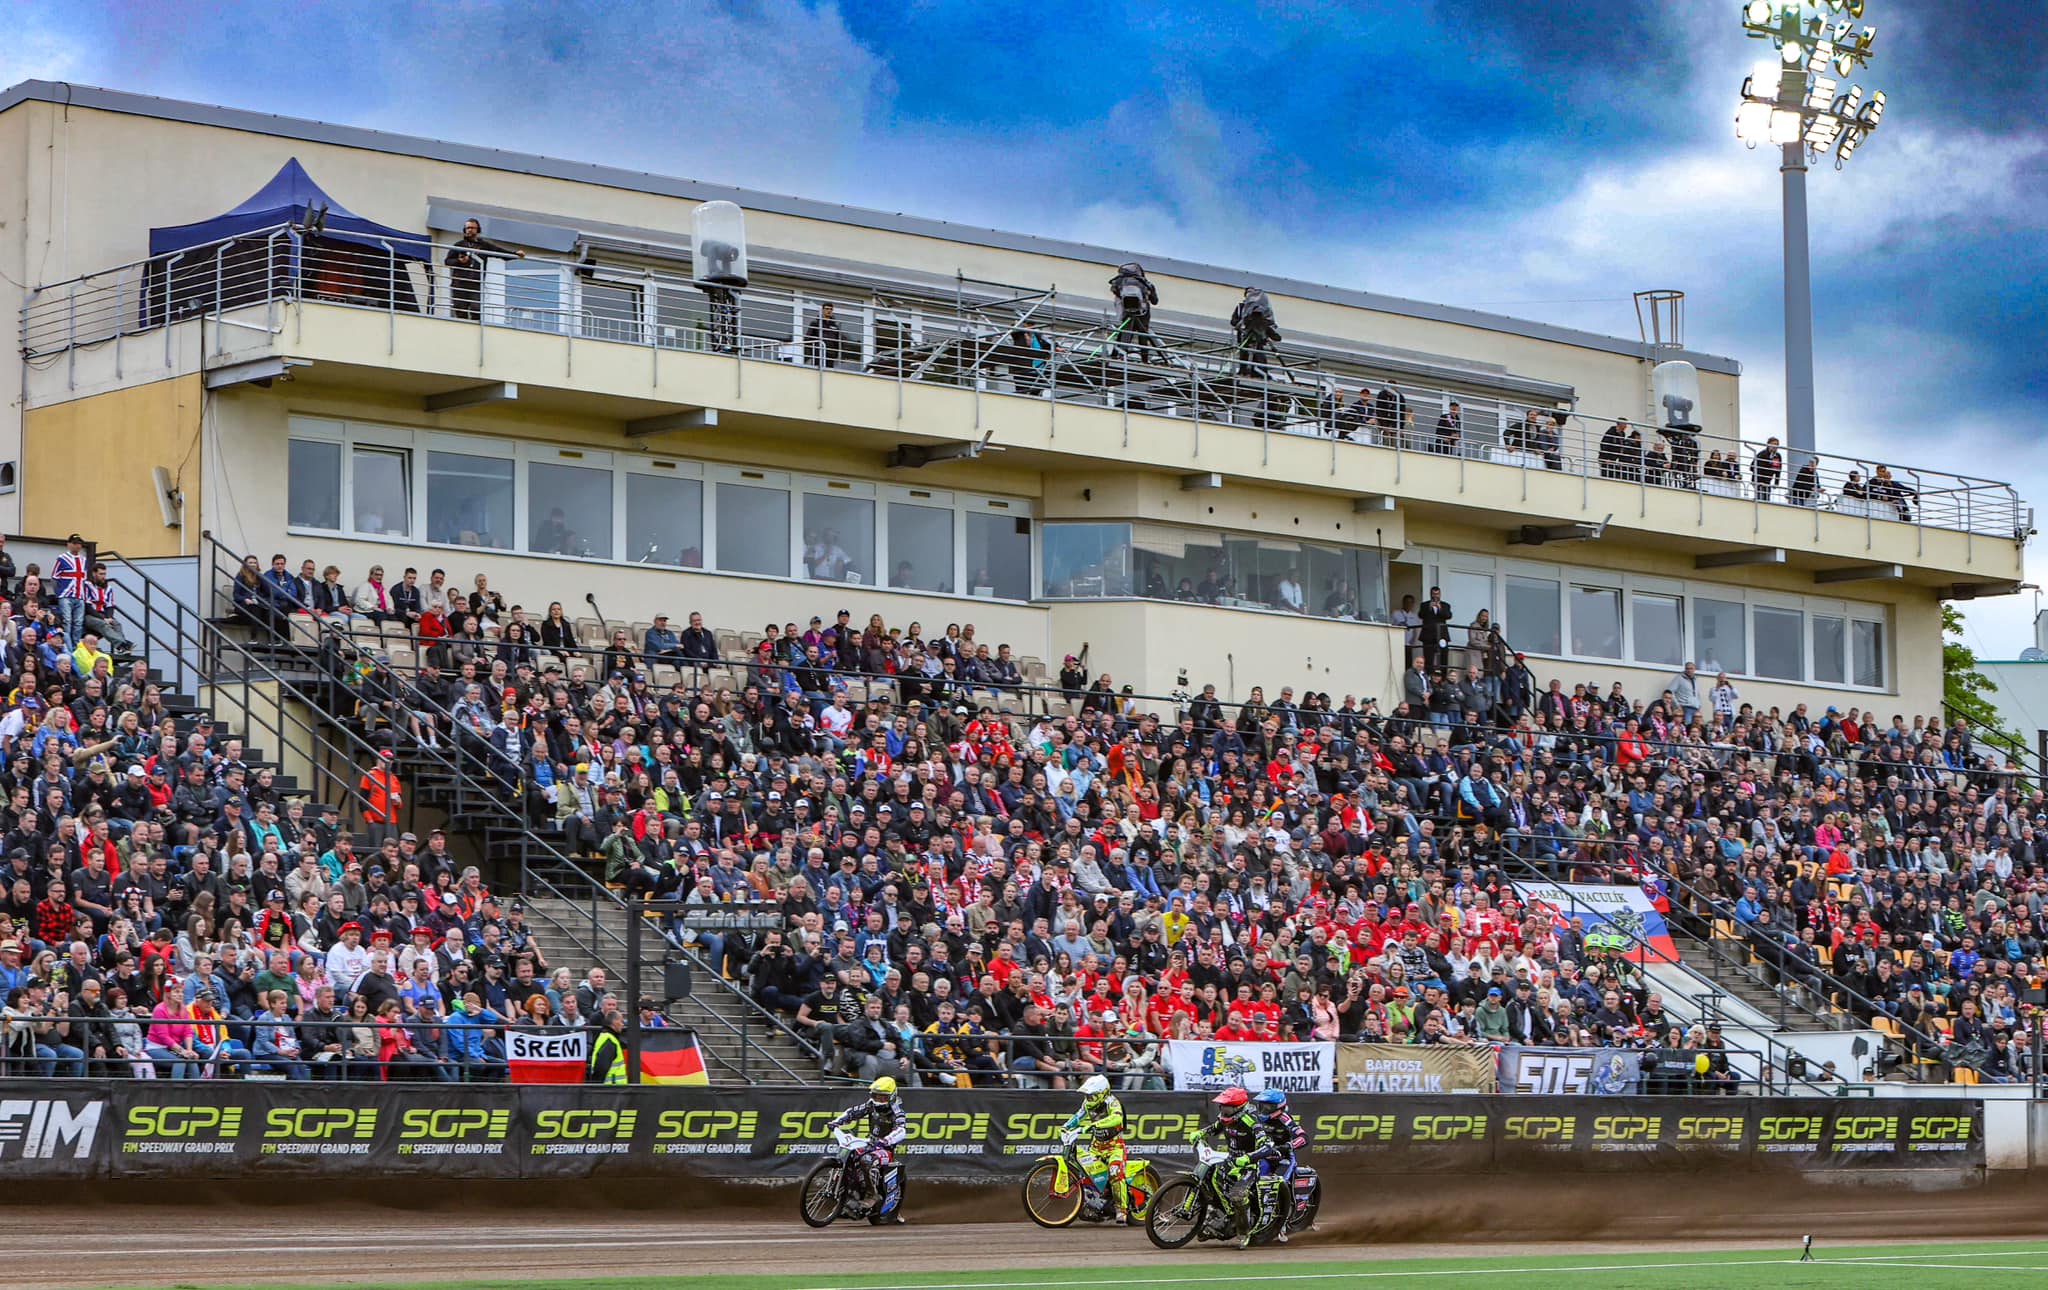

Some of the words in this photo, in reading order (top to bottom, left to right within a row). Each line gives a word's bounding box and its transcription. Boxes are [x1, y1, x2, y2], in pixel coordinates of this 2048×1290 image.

[1534, 889, 1575, 901] MARTI
[1577, 891, 1628, 903] VACULÍK
[514, 1035, 581, 1058] ŚREM
[1201, 1046, 1226, 1076] 95
[1262, 1051, 1321, 1073] BARTEK
[1366, 1059, 1422, 1072] BARTOSZ
[1264, 1076, 1320, 1093] ZMARZLIK
[1346, 1072, 1444, 1093] ZMARZLIK
[0, 1101, 104, 1158] FIM
